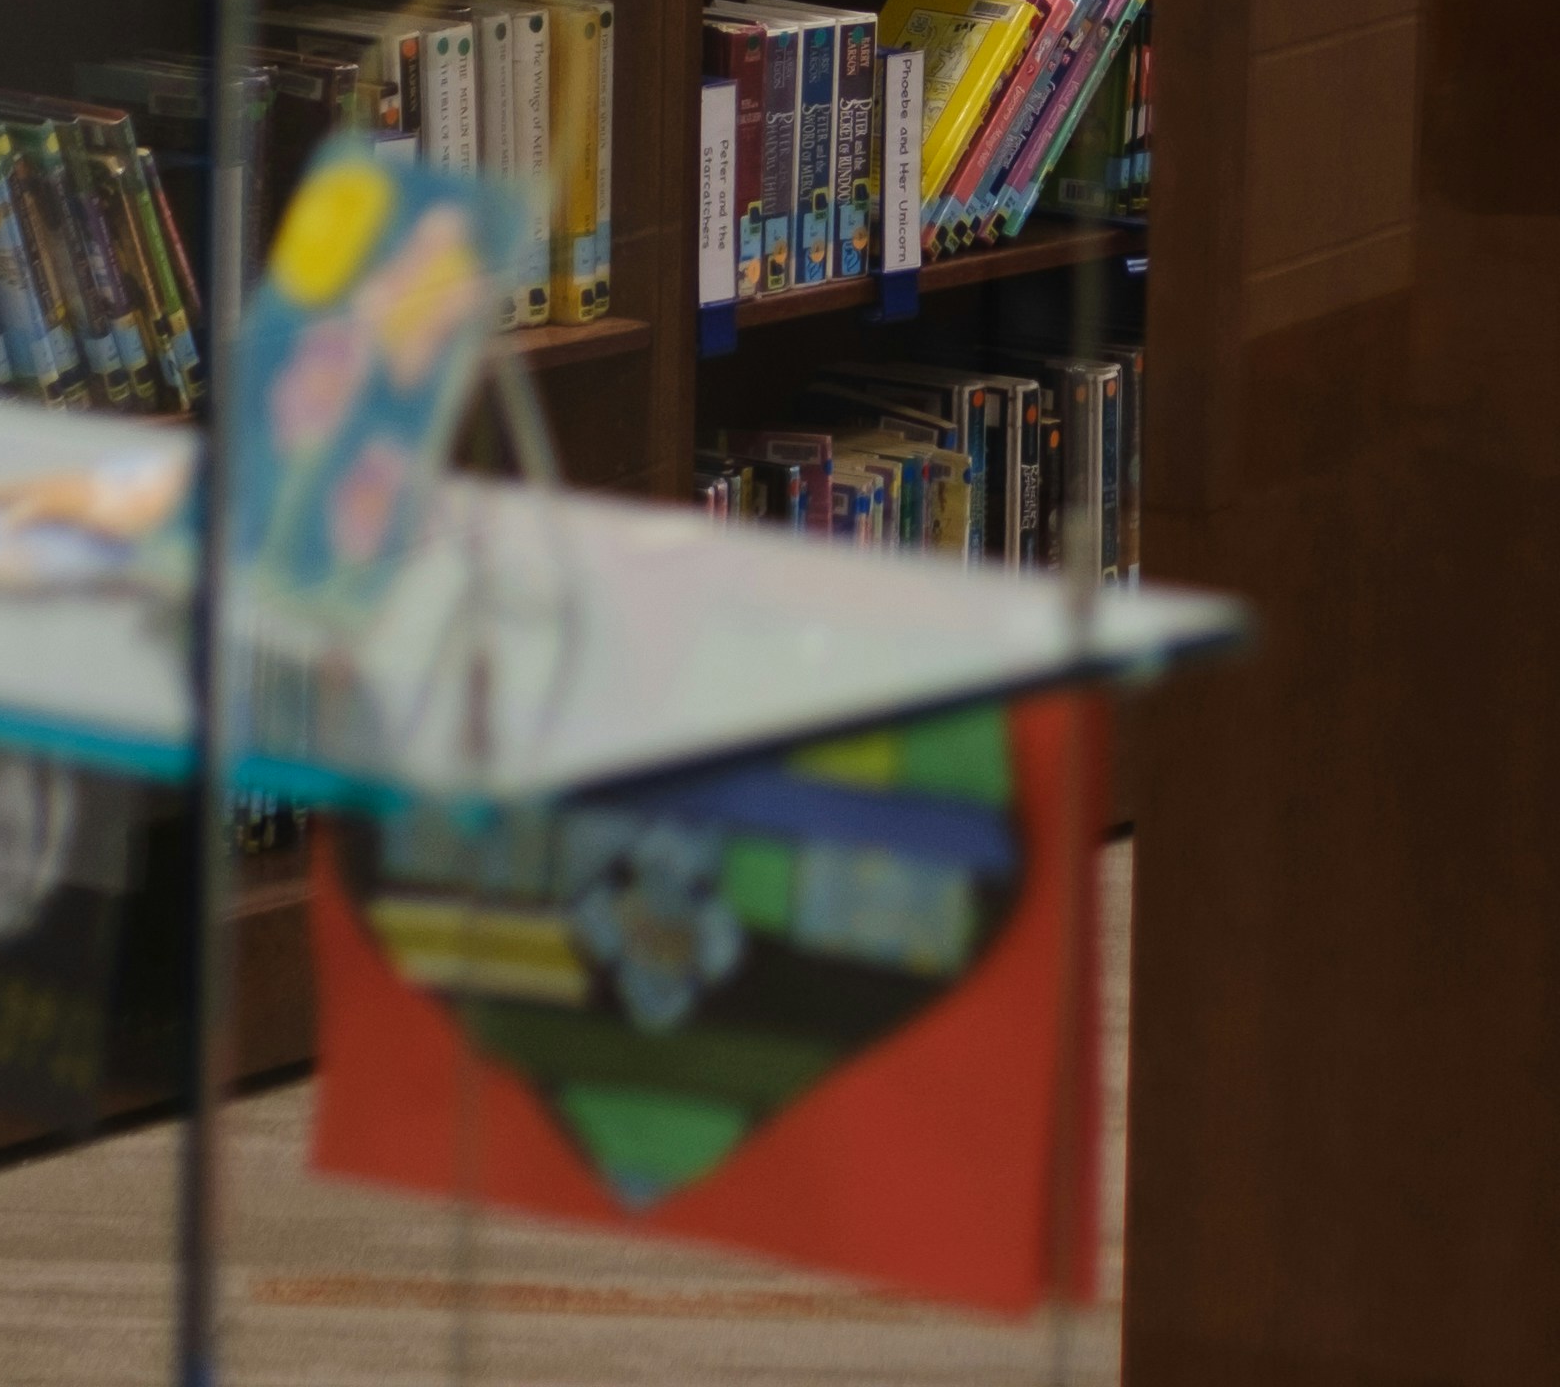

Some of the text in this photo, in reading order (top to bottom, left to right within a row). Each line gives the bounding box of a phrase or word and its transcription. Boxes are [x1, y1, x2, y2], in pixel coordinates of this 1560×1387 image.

[533, 42, 544, 65] The
[460, 88, 470, 137] MERLIN
[529, 71, 544, 113] Wings
[532, 117, 544, 131] of
[779, 111, 795, 156] PETER
[802, 103, 819, 149] SWORD
[816, 103, 832, 141] PETER
[839, 97, 855, 142] SECRET
[853, 97, 873, 171] PETER and the
[799, 164, 813, 202] MERCY
[898, 59, 913, 263] Phoebe and Her Unicorn
[702, 147, 714, 249] Starcatchers
[718, 139, 730, 251] Peter and the
